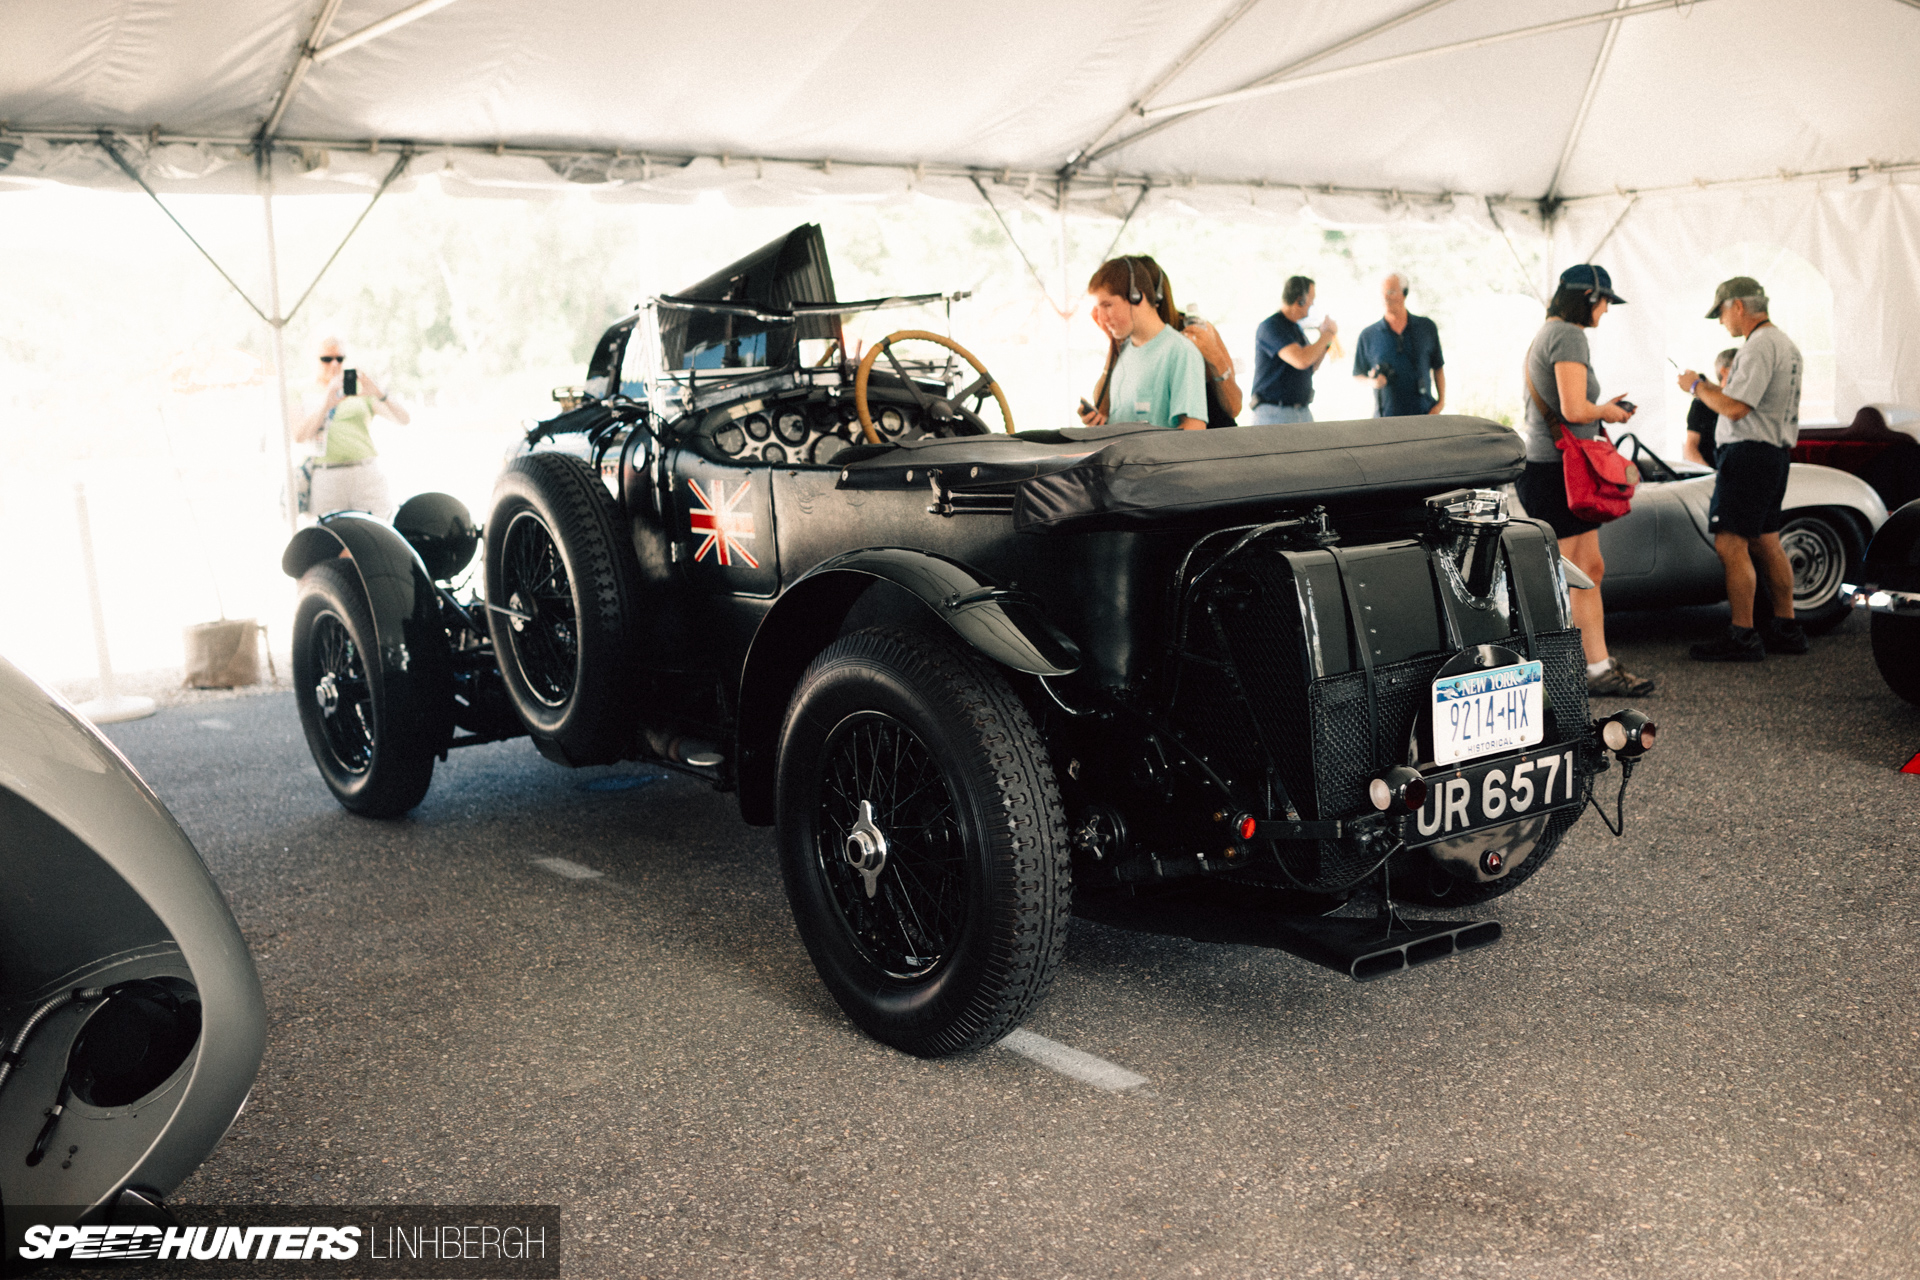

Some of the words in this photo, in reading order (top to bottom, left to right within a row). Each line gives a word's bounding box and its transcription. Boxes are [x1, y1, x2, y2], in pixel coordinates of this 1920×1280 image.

[1461, 676, 1488, 697] NEW
[1489, 669, 1518, 690] YORK
[1468, 737, 1514, 753] HISTORICAL
[1417, 777, 1470, 837] UR
[1482, 750, 1573, 819] 6571
